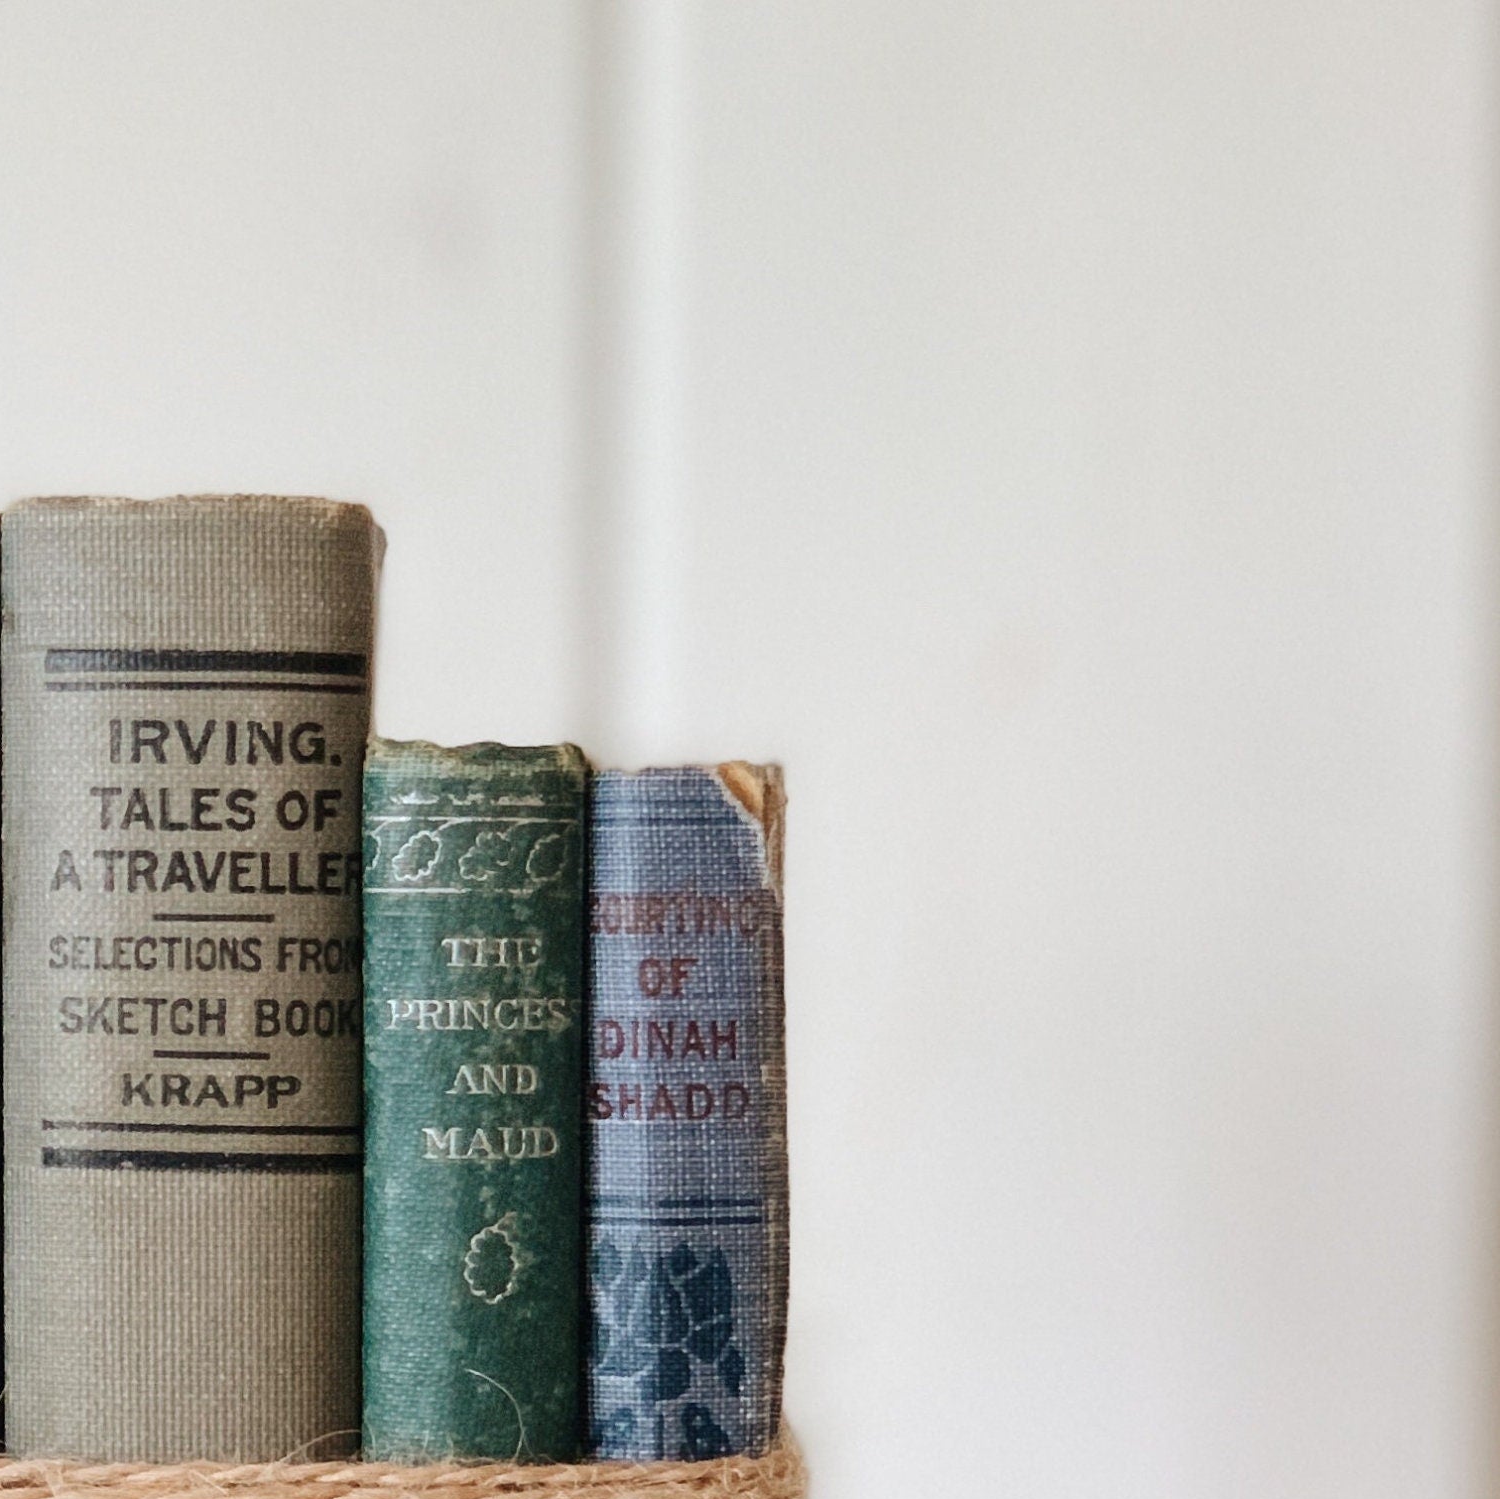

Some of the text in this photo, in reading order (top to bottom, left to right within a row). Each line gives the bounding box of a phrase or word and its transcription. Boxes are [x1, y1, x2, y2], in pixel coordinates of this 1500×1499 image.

[108, 719, 342, 766] IRVING.
[90, 786, 342, 832] TALES OF
[49, 849, 83, 893] A
[48, 935, 262, 973] SELECTIONS
[441, 937, 543, 968] THE
[638, 957, 699, 998] OF
[59, 996, 363, 1038] SKETCH BOOK
[597, 1019, 738, 1061] DINAH
[121, 1072, 301, 1110] KRAPP
[444, 1064, 539, 1095] AND
[588, 1081, 752, 1121] SHADD
[421, 1127, 559, 1161] MAUD
